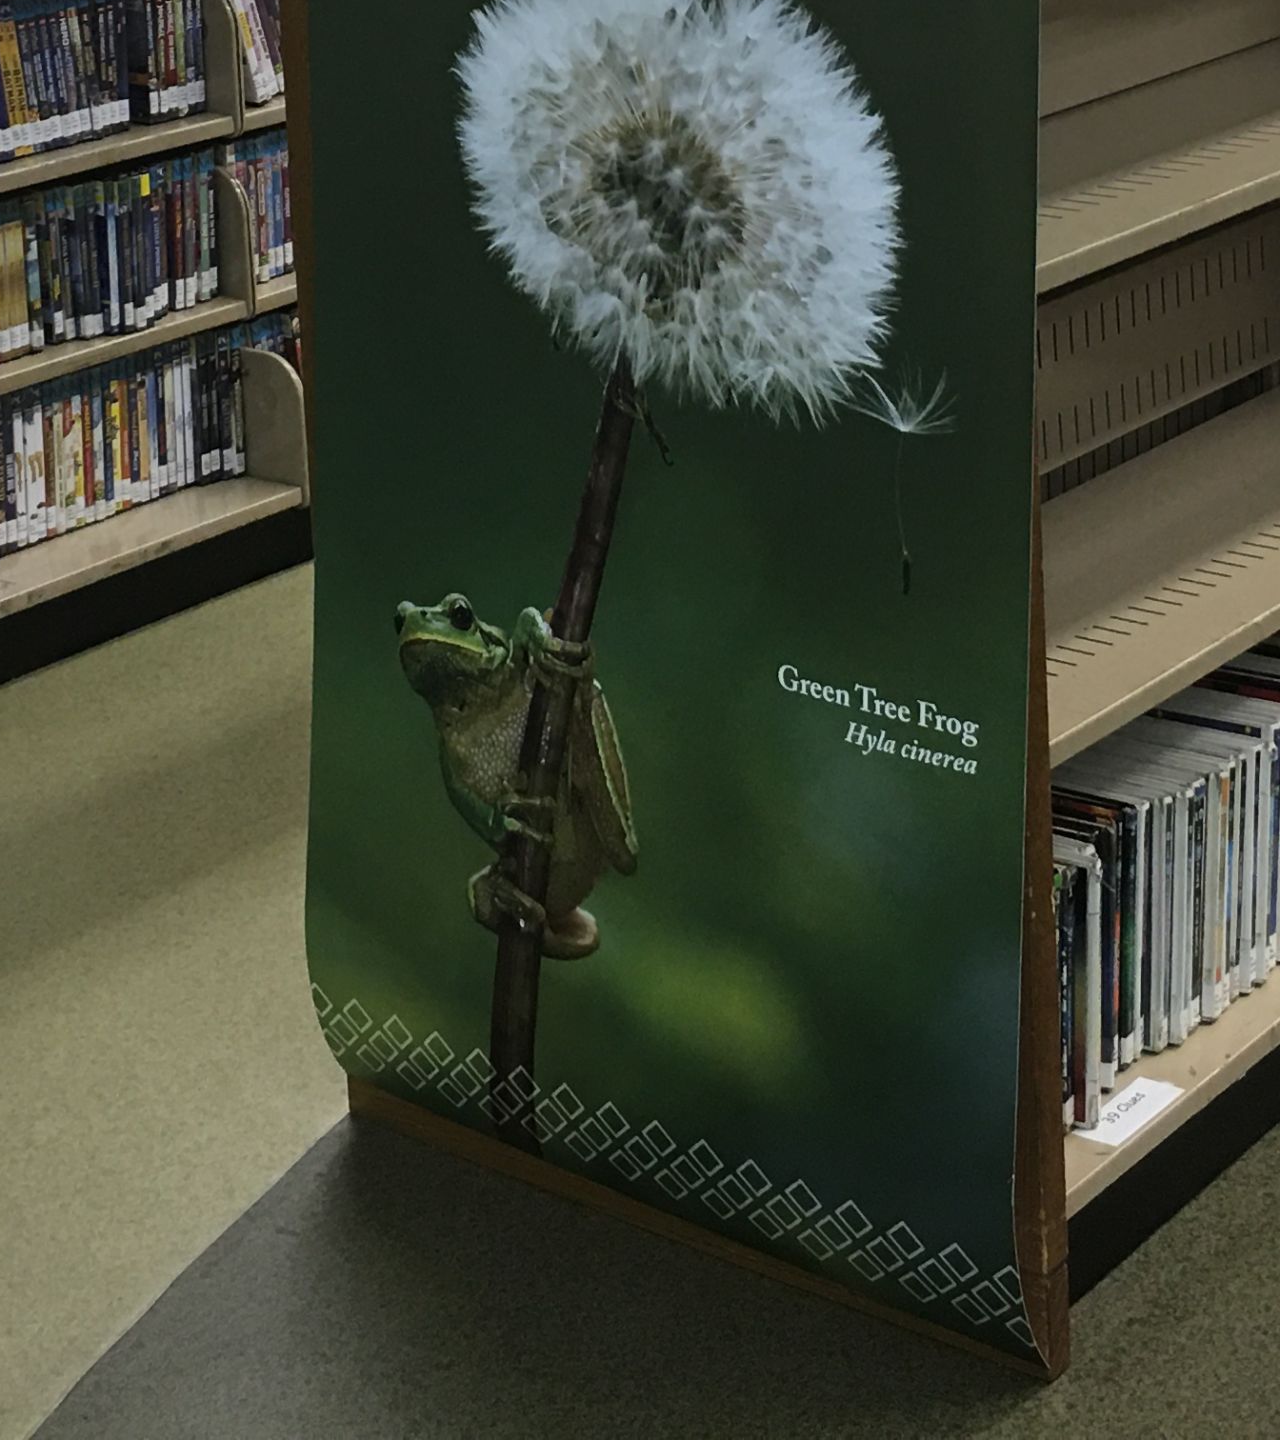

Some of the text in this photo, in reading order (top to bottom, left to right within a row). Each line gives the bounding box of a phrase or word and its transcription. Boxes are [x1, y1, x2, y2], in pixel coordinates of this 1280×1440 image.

[777, 663, 980, 748] Green Tree Frog
[844, 720, 978, 775] Hyla cinerea
[1102, 1091, 1146, 1125] 39 Clues
